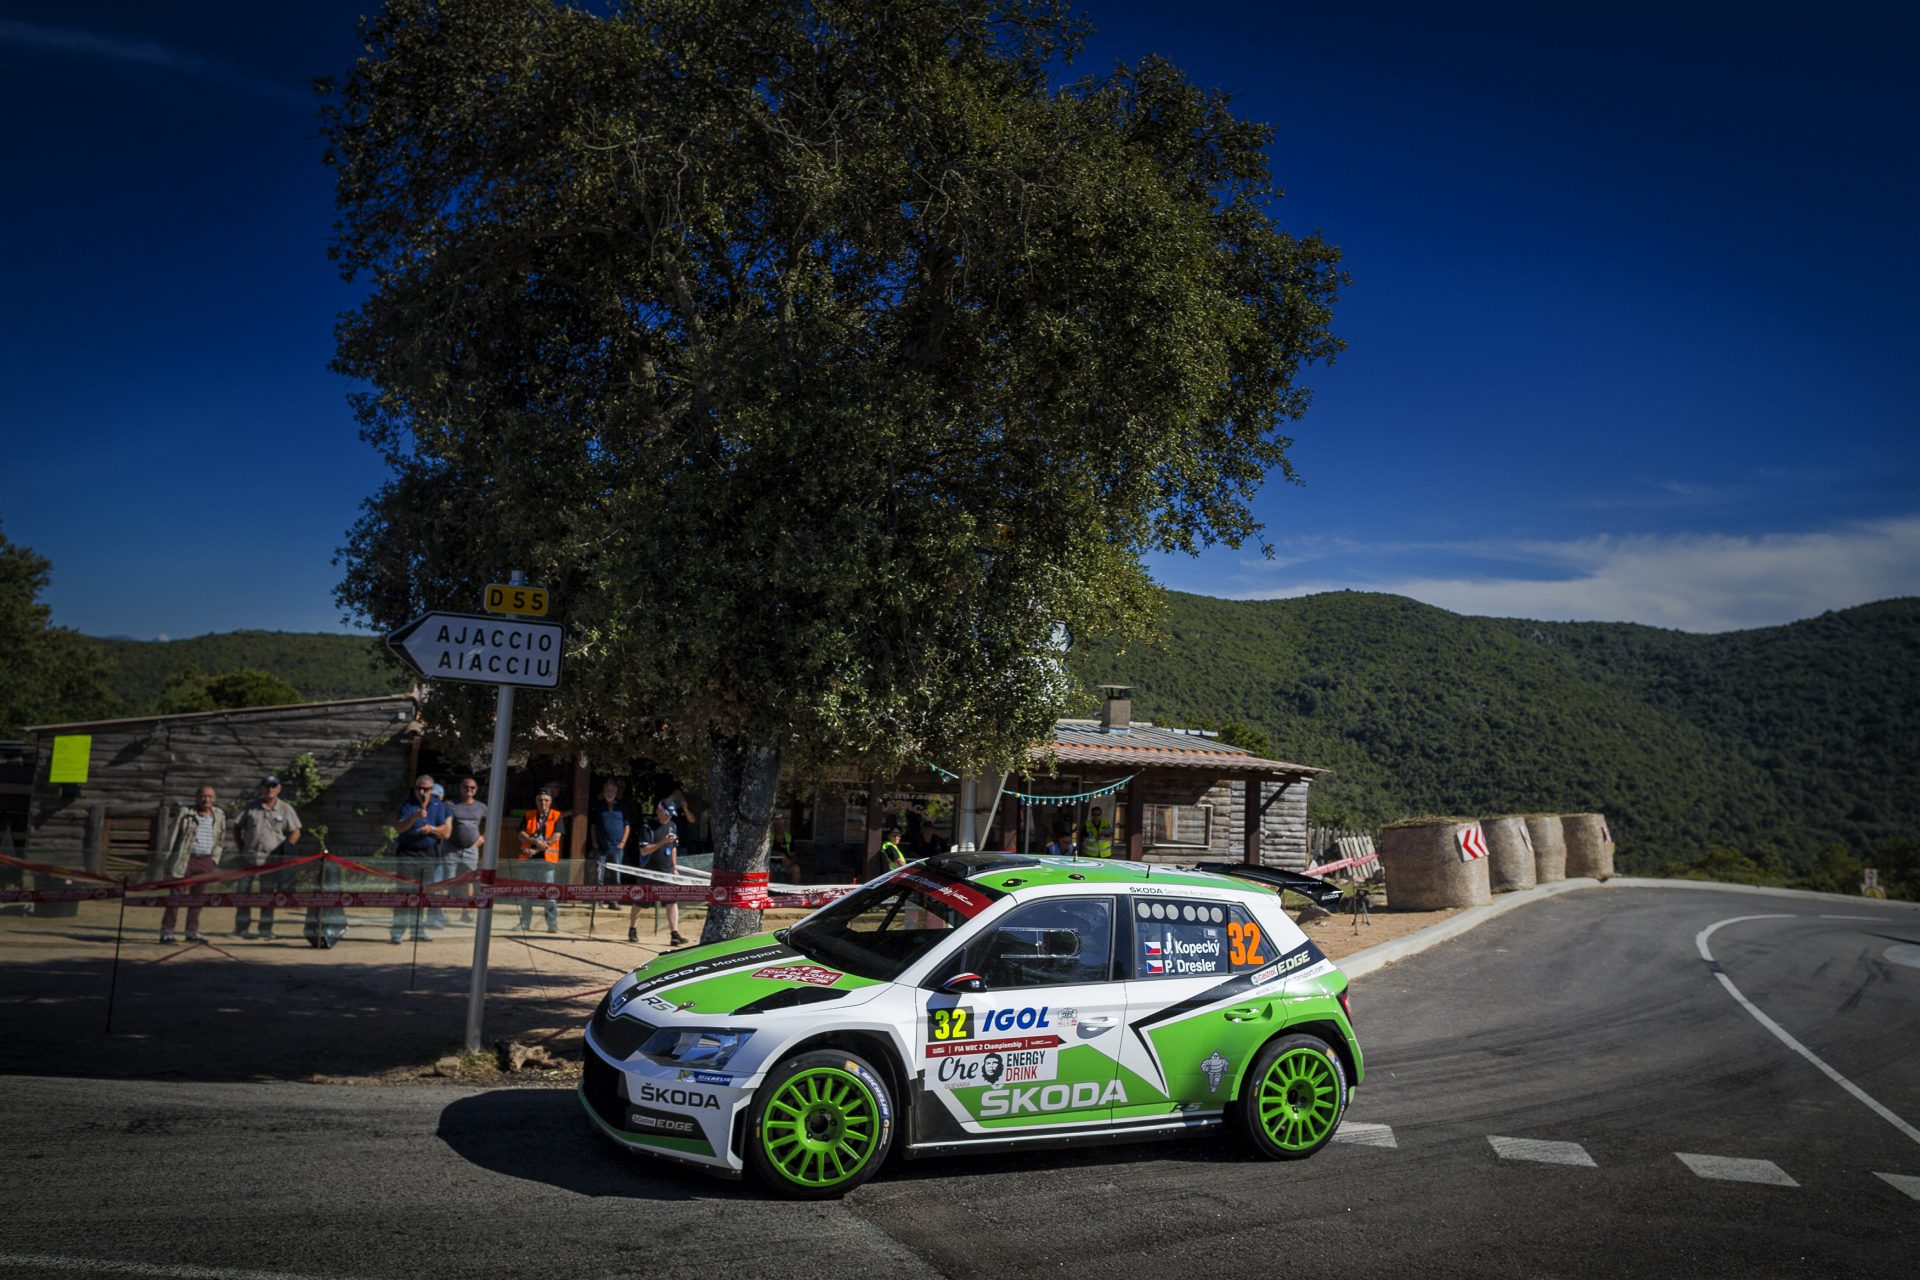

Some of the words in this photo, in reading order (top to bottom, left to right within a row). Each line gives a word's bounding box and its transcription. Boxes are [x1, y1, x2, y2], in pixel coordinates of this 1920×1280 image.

[490, 589, 503, 607] D
[512, 591, 544, 611] 55
[436, 625, 552, 652] AJACCIO
[438, 651, 551, 677] AIACCIU
[1163, 942, 1174, 955] J.
[1175, 939, 1220, 957] Kopecký
[1227, 922, 1265, 966] 32
[711, 949, 783, 967] Motorsport
[1164, 960, 1175, 973] P.
[1177, 959, 1216, 973] Dresler
[1277, 949, 1311, 975] EDGE
[641, 995, 673, 1011] R5
[934, 1008, 967, 1040] 32
[982, 1006, 1051, 1033] IGOL
[954, 1045, 965, 1053] FIA
[965, 1044, 978, 1052] WRC
[983, 1041, 1023, 1051] Championship
[938, 1056, 979, 1082] Che
[1006, 1051, 1046, 1068] ENERGY
[1005, 1066, 1038, 1082] DRINK
[697, 1074, 732, 1083] MICHELIN
[944, 1082, 971, 1090] GUEVARA
[640, 1082, 721, 1111] ŠKODA
[980, 1079, 1129, 1117] ŠKODA
[656, 1119, 694, 1132] EDGE
